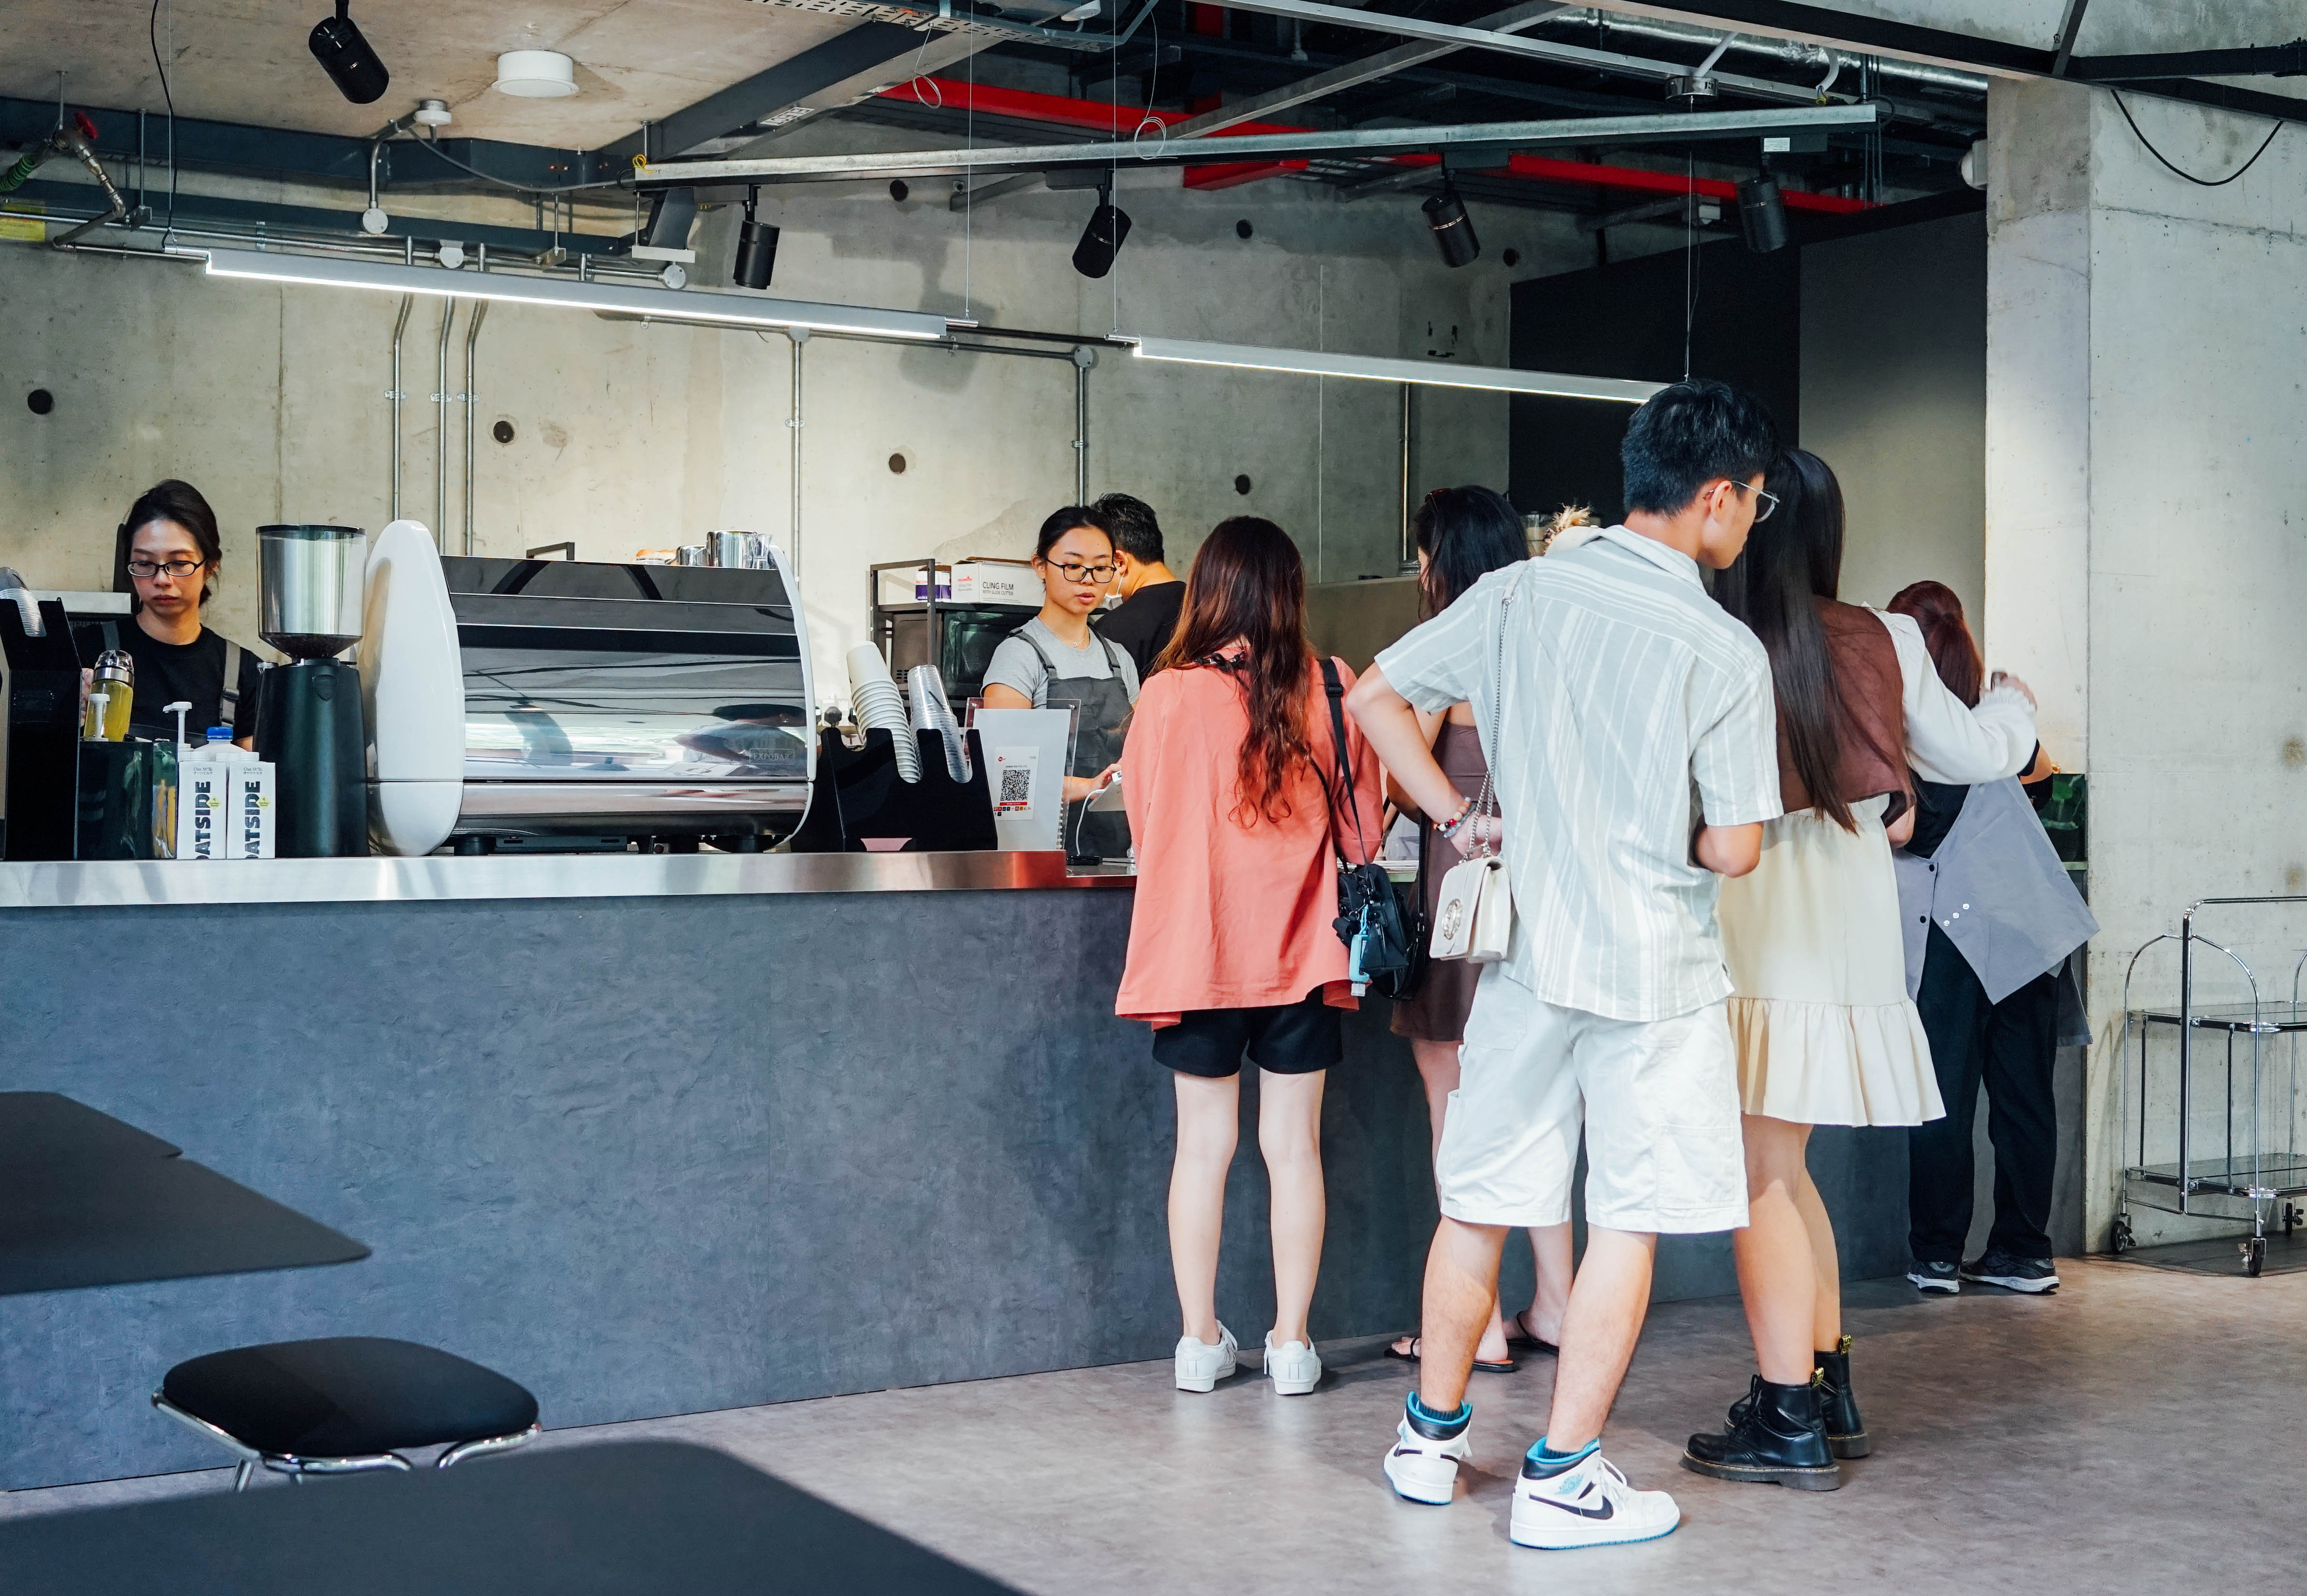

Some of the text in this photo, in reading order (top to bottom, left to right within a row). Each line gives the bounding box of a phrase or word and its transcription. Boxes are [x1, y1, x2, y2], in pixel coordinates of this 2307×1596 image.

[765, 109, 811, 124] ELECT
[195, 782, 211, 858] ATSIDE
[245, 782, 260, 858] ATSIDE
